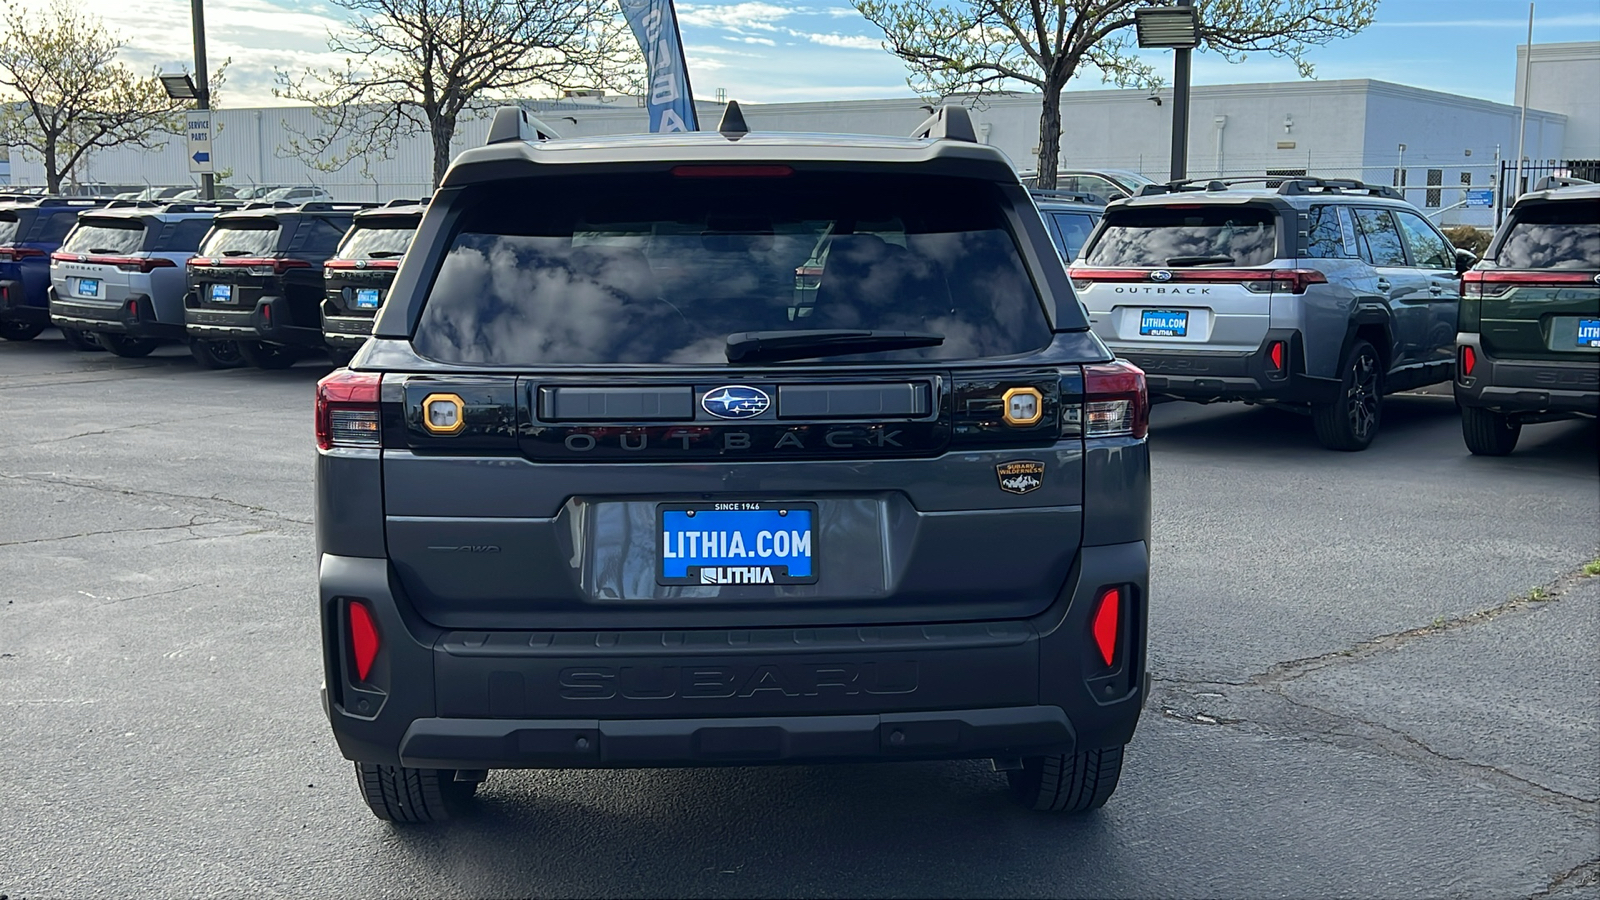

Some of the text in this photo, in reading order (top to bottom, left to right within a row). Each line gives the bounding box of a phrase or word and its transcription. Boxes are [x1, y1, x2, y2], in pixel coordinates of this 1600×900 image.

[188, 121, 209, 129] SERVICE
[191, 133, 208, 141] PARTS
[1142, 318, 1185, 328] LITHIA.COM
[564, 430, 904, 451] OUTBACK
[663, 530, 811, 558] LITHIA.COM
[717, 567, 774, 584] LITHIA
[559, 661, 919, 700] SUBARU
